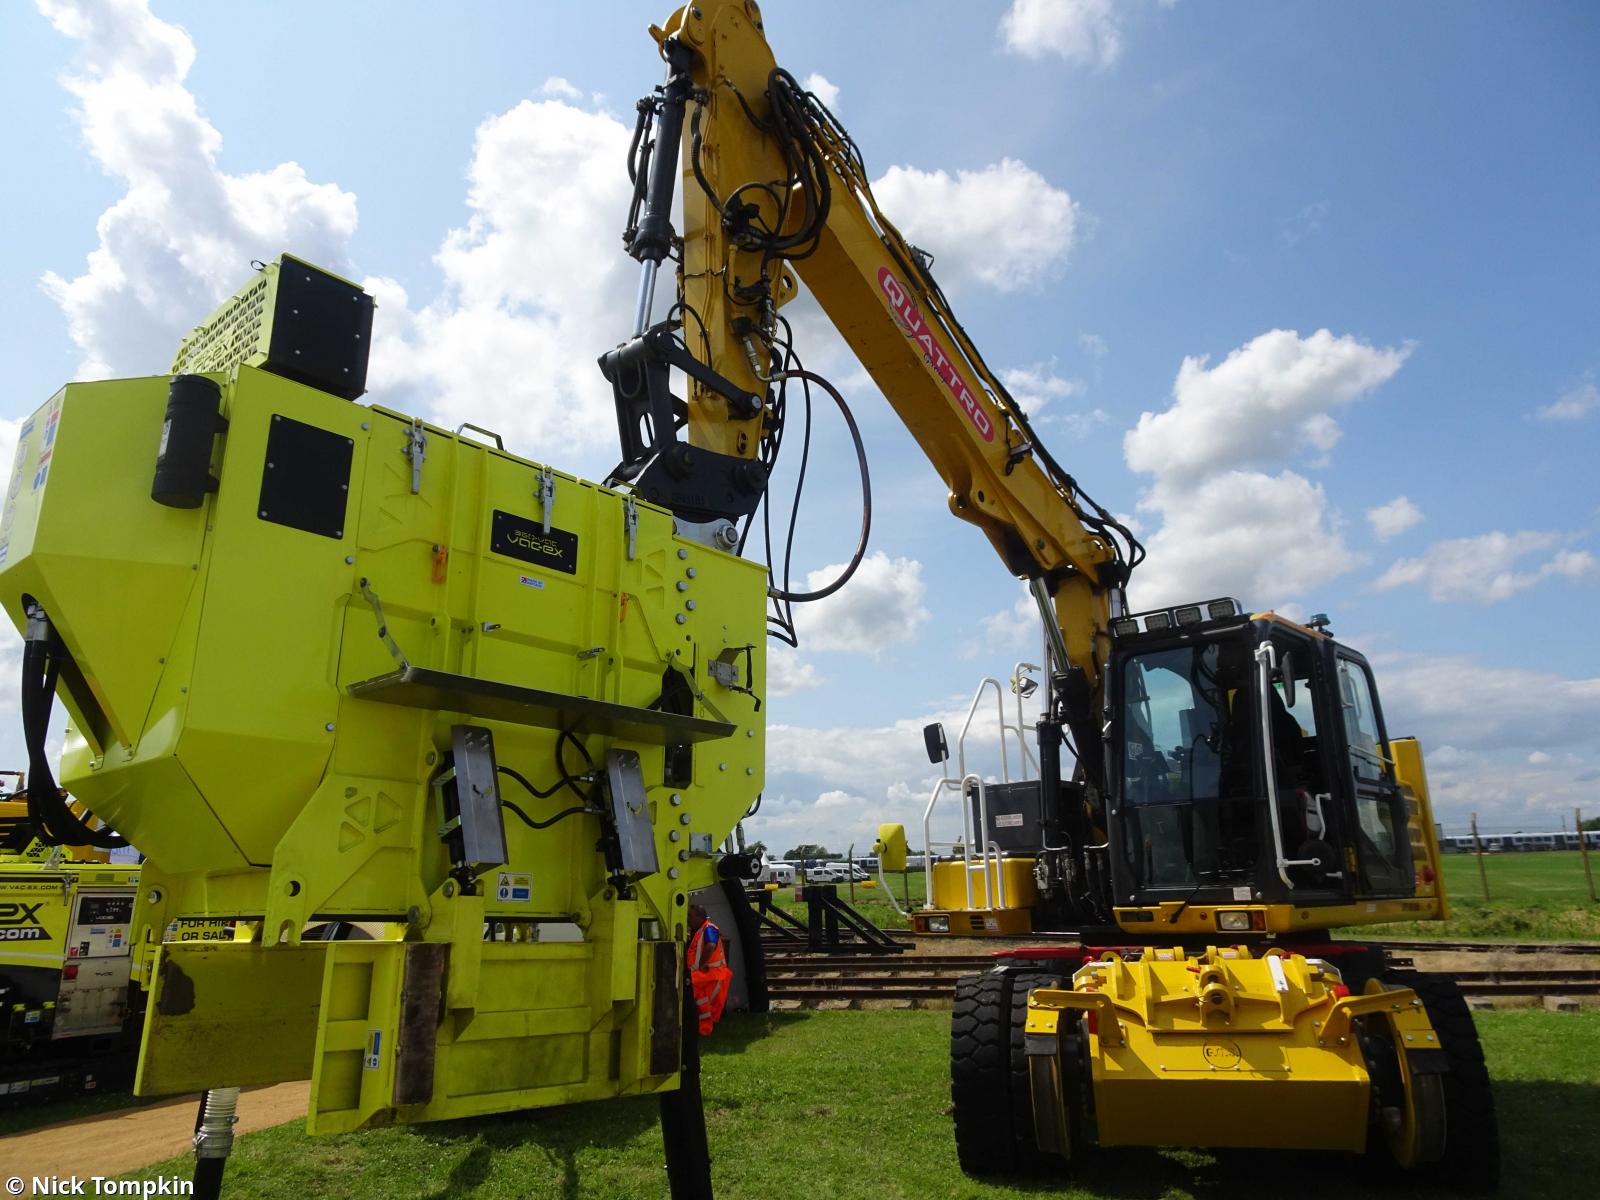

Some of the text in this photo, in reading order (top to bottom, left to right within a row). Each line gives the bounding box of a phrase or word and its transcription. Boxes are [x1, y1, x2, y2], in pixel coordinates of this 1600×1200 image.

[883, 274, 990, 434] QUATTRO
[182, 931, 226, 941] OR SAL
